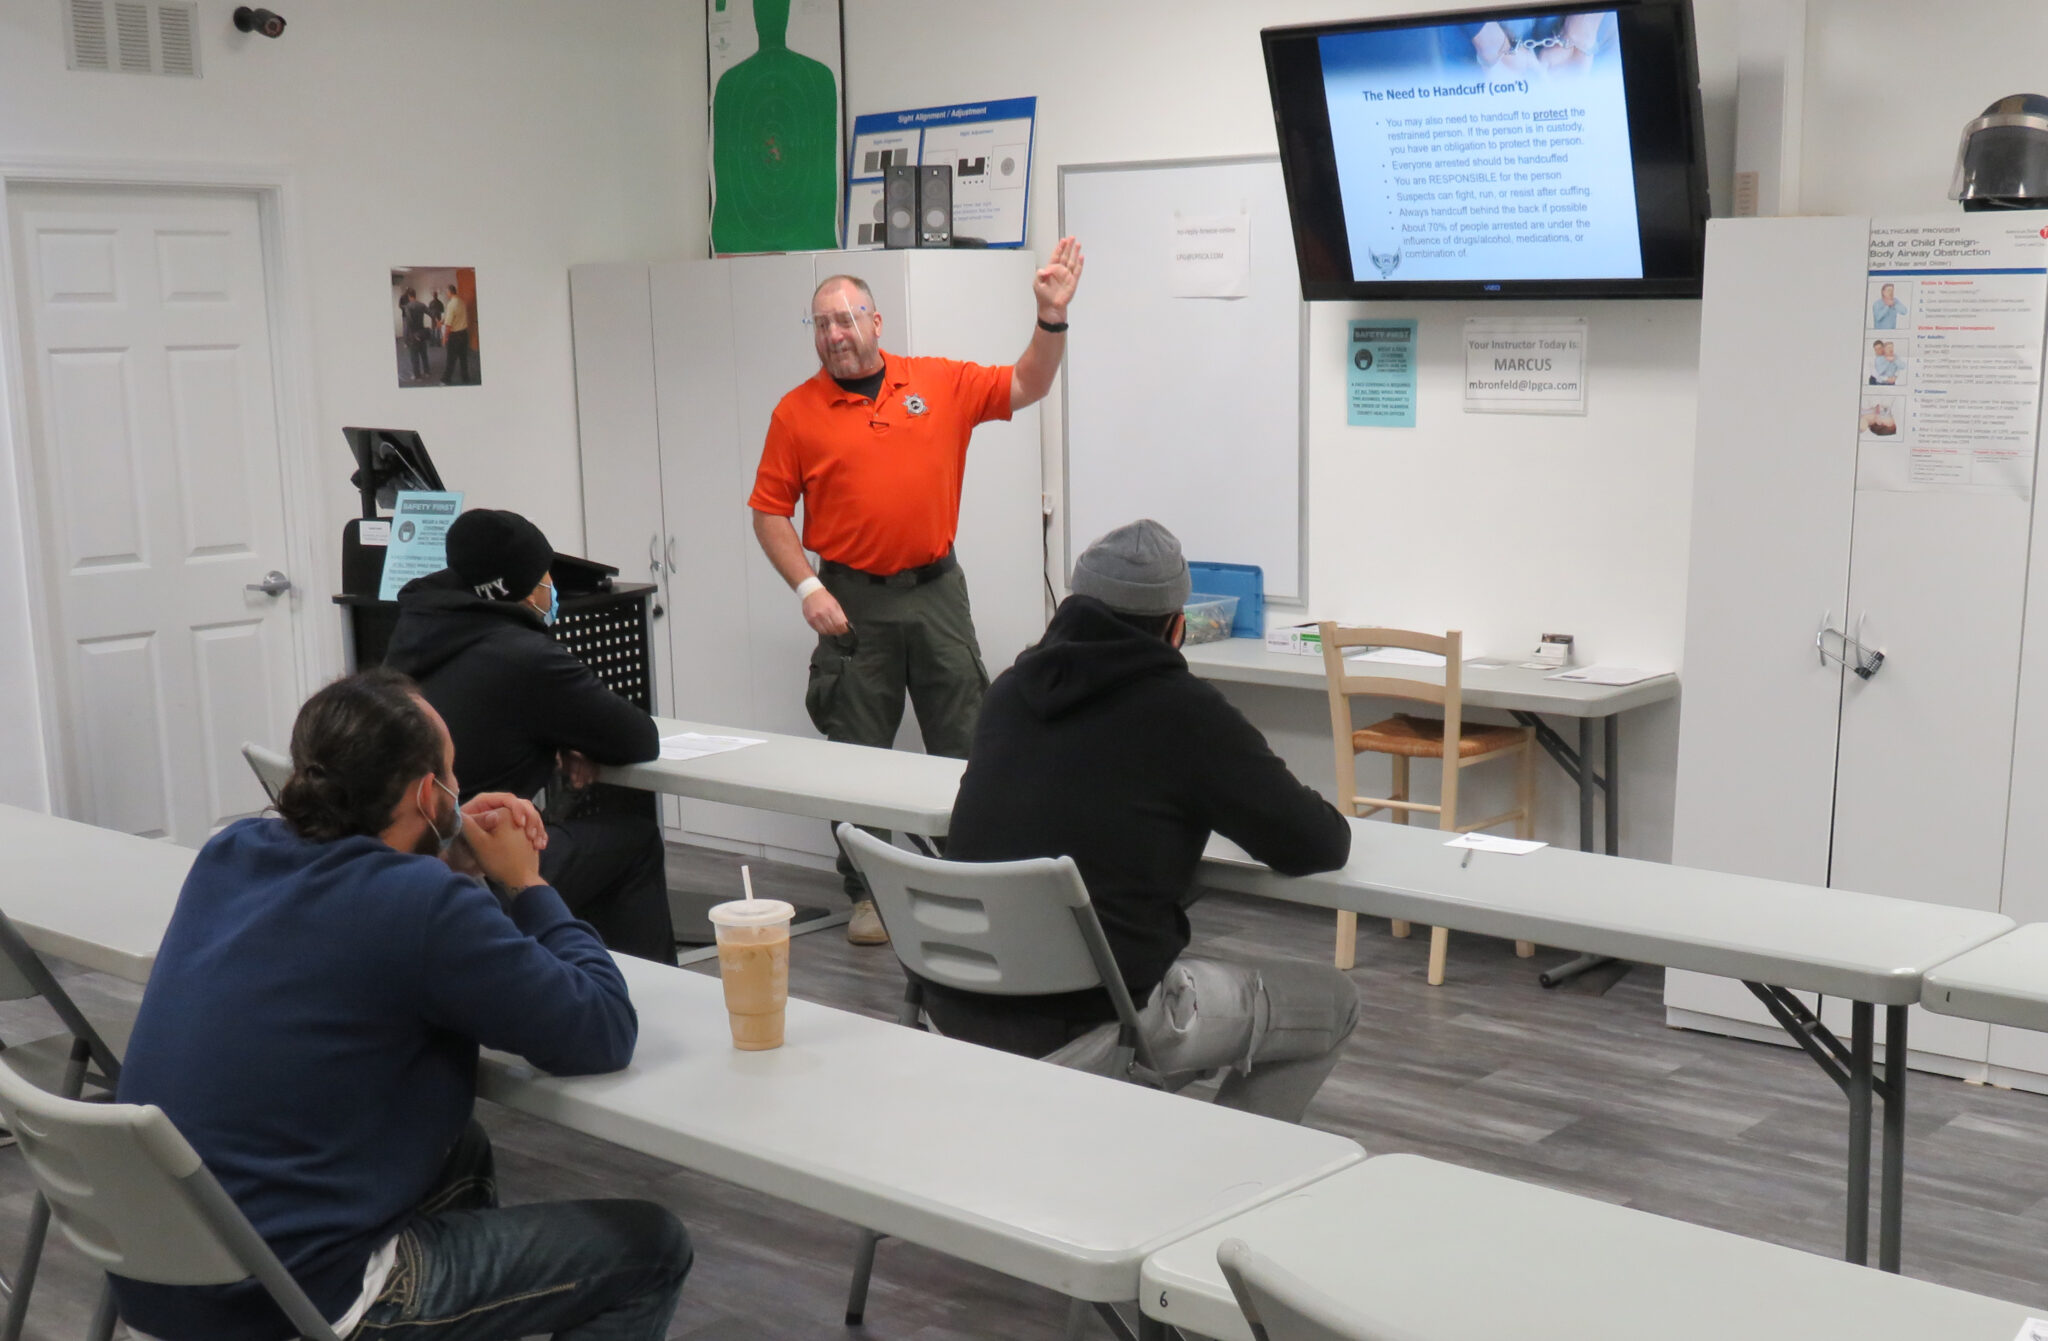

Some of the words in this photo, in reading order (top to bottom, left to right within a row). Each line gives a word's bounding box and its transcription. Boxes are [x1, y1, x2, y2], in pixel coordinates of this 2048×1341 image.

[1362, 90, 1384, 101] The
[1386, 88, 1415, 100] Need
[1418, 87, 1430, 98] to
[1433, 83, 1486, 97] Handcuff
[1489, 80, 1529, 96] (con't)
[897, 114, 914, 124] Sight
[914, 110, 946, 122] Alignment
[951, 106, 987, 118] Adjustment
[1386, 118, 1402, 127] You
[1404, 118, 1423, 128] may
[1425, 116, 1443, 126] also
[1446, 114, 1467, 124] need
[1469, 114, 1479, 123] to
[1480, 111, 1519, 122] handcuff
[1521, 111, 1531, 120] to
[1533, 108, 1568, 121] protect
[1570, 107, 1586, 117] the
[1387, 129, 1431, 141] restrained
[1467, 127, 1473, 137] If
[1475, 127, 1490, 136] the
[1492, 125, 1523, 137] person
[1525, 125, 1533, 133] is
[1536, 124, 1544, 133] in
[1389, 146, 1405, 156] you
[1407, 144, 1429, 153] have
[1431, 144, 1441, 152] an
[1444, 141, 1486, 154] obligation
[1488, 141, 1497, 150] to
[1499, 139, 1531, 151] protect
[1532, 138, 1547, 147] the
[1392, 160, 1432, 171] Everyone
[1434, 158, 1470, 168] arrested
[1472, 156, 1502, 166] should
[1504, 156, 1516, 165] be
[1518, 153, 1568, 165] handcuffed
[1394, 176, 1411, 186] You
[1413, 177, 1427, 185] are
[1428, 172, 1497, 184] RESPONSIBLE
[1499, 172, 1511, 182] for
[1513, 171, 1528, 181] the
[1530, 171, 1562, 182] person
[1396, 191, 1436, 203] Suspects
[1438, 191, 1453, 200] can
[1455, 190, 1477, 202] fight,
[1498, 190, 1508, 198] or
[1510, 188, 1535, 197] resist
[1537, 187, 1558, 196] after
[1399, 207, 1429, 218] Always
[1430, 205, 1468, 217] handcuff
[1470, 204, 1500, 215] behind
[1501, 205, 1516, 214] the
[1518, 203, 1540, 213] back
[1542, 203, 1548, 212] if
[1550, 202, 1588, 214] possible
[1401, 223, 1426, 233] About
[1428, 222, 1448, 232] 70%
[1449, 222, 1458, 231] of
[1460, 221, 1490, 233] people
[1491, 220, 1528, 230] arrested
[1530, 221, 1545, 229] are
[1547, 219, 1573, 229] under
[1575, 218, 1591, 228] the
[1871, 228, 1919, 236] HEALTHCARE
[1403, 236, 1441, 246] influence
[1443, 235, 1451, 245] of
[1574, 234, 1584, 242] or
[1870, 240, 1894, 248] Adult
[1911, 239, 1936, 247] Child
[1938, 238, 1980, 249] Foreign-
[1405, 248, 1456, 258] combination
[1869, 250, 1894, 259] Body
[1897, 249, 1930, 258] Airway
[1933, 247, 1991, 257] Obstruction
[1468, 340, 1490, 350] Your
[1491, 339, 1536, 350] Instructor
[1538, 339, 1566, 351] Today
[1494, 358, 1552, 371] MARCUS
[1469, 379, 1577, 392] mbronfeld@lpgca.com
[403, 503, 431, 511] SAFETY
[432, 503, 455, 511] FIRST
[1159, 1291, 1169, 1308] 6
